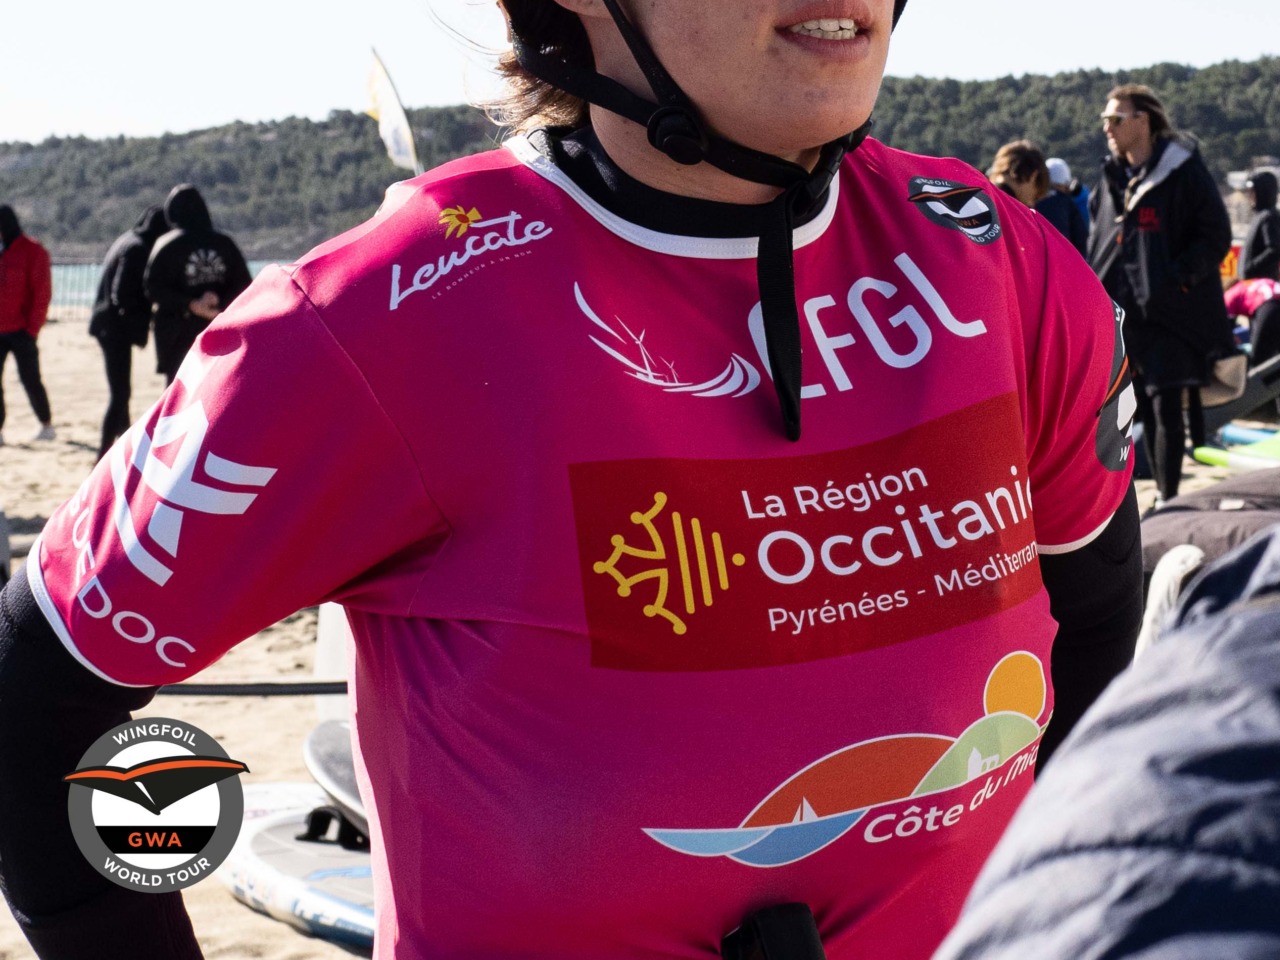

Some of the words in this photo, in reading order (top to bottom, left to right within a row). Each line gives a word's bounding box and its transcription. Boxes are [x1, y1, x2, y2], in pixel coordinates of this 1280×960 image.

[389, 210, 553, 311] Leucate
[431, 291, 442, 300] LE
[446, 263, 486, 290] BONHEUR
[514, 250, 532, 259] NOM
[741, 489, 787, 520] La
[793, 466, 929, 515] Région
[757, 465, 1034, 585] Occitani
[768, 589, 909, 635] Pyrénées
[863, 803, 965, 844] Côte
[969, 775, 1003, 812] du
